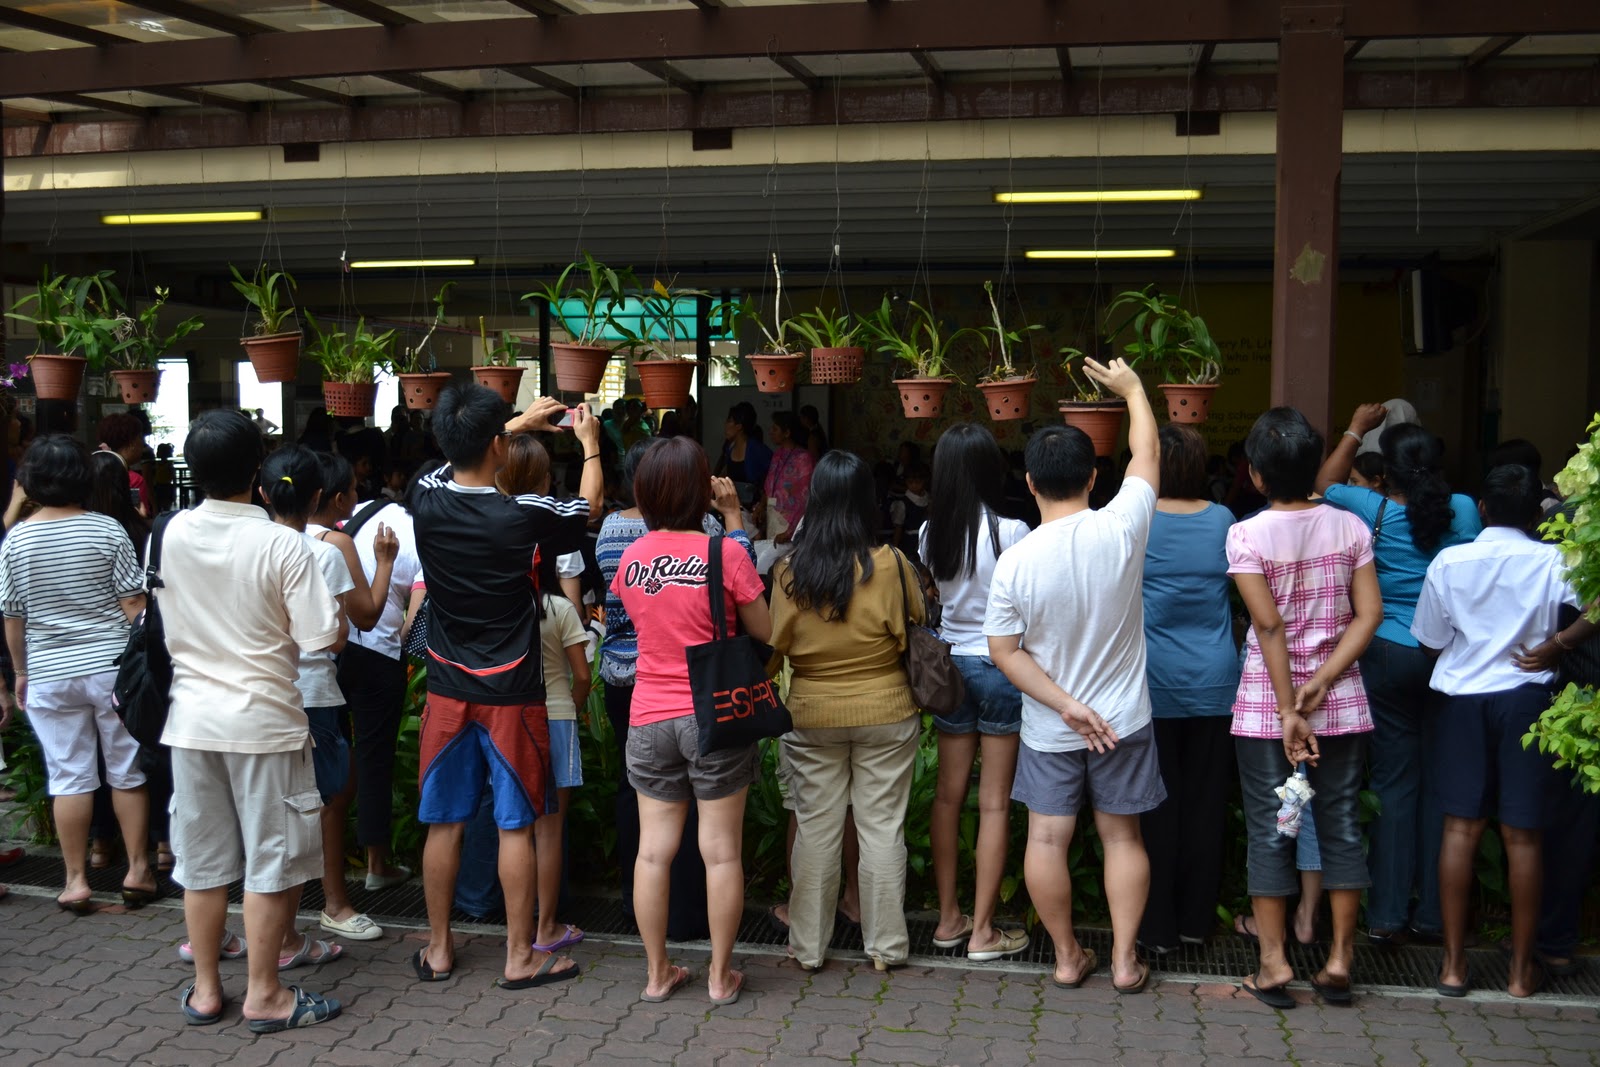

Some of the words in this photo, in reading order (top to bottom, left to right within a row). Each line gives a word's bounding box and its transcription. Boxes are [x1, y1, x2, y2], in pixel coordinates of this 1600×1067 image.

[1226, 351, 1249, 361] who
[624, 561, 649, 587] Op
[651, 555, 710, 578] Ridin
[713, 679, 778, 723] ESPRI
